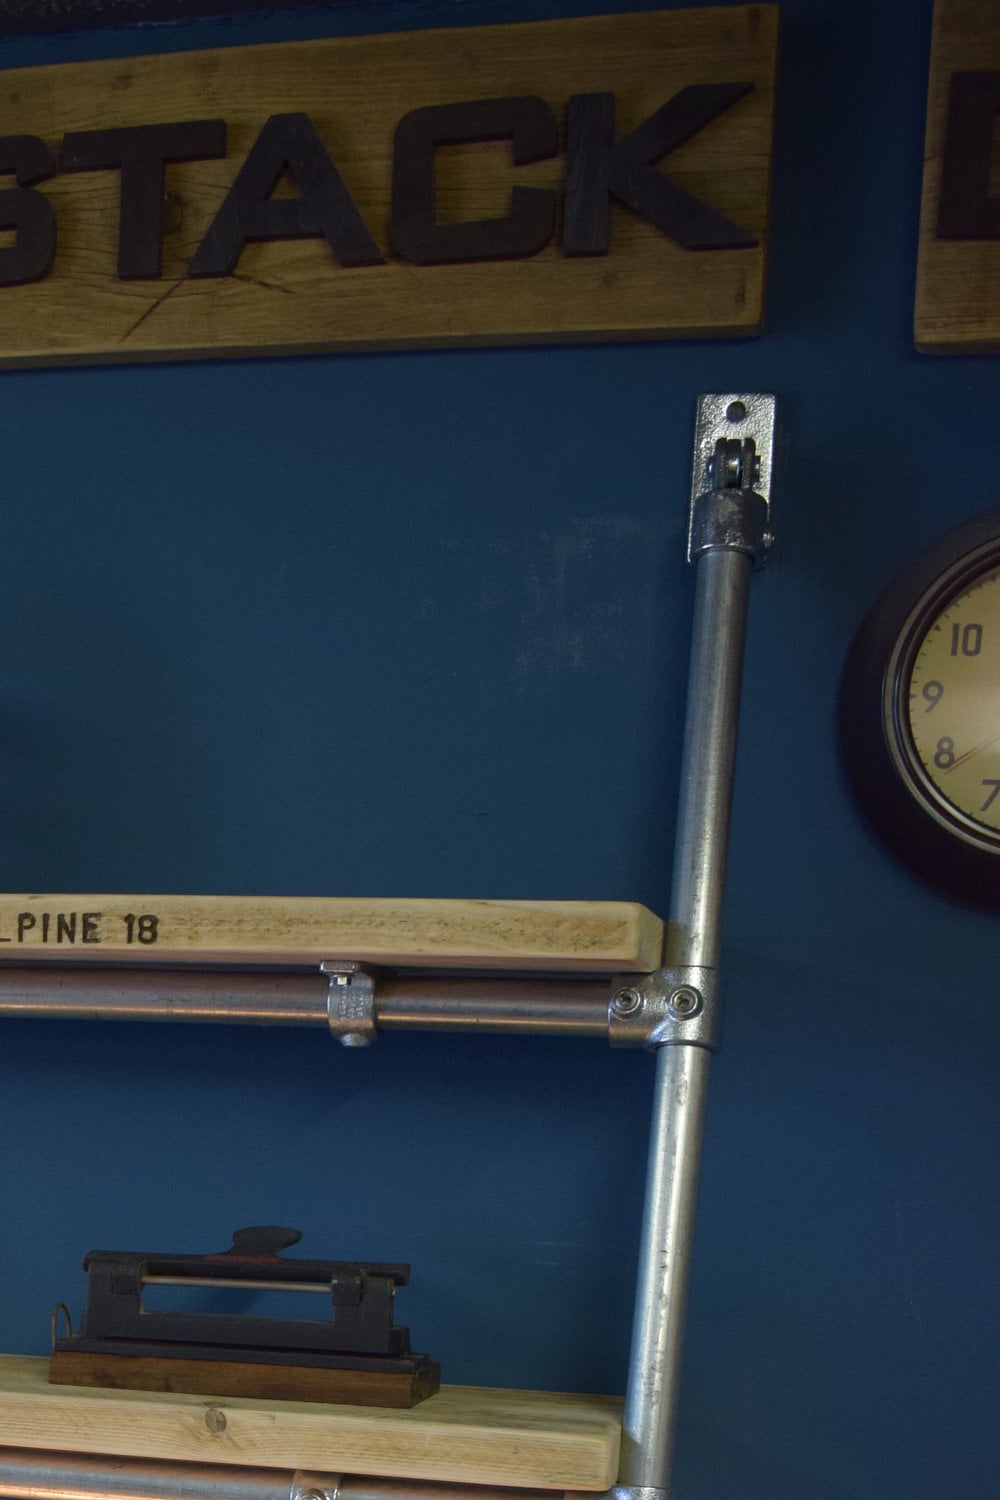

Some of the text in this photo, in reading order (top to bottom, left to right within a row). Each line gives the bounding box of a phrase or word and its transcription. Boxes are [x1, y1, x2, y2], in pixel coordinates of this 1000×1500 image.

[950, 622, 983, 657] 10
[922, 680, 944, 713] 9
[934, 736, 955, 770] 8
[980, 779, 1000, 812] 7
[124, 913, 159, 945] 18
